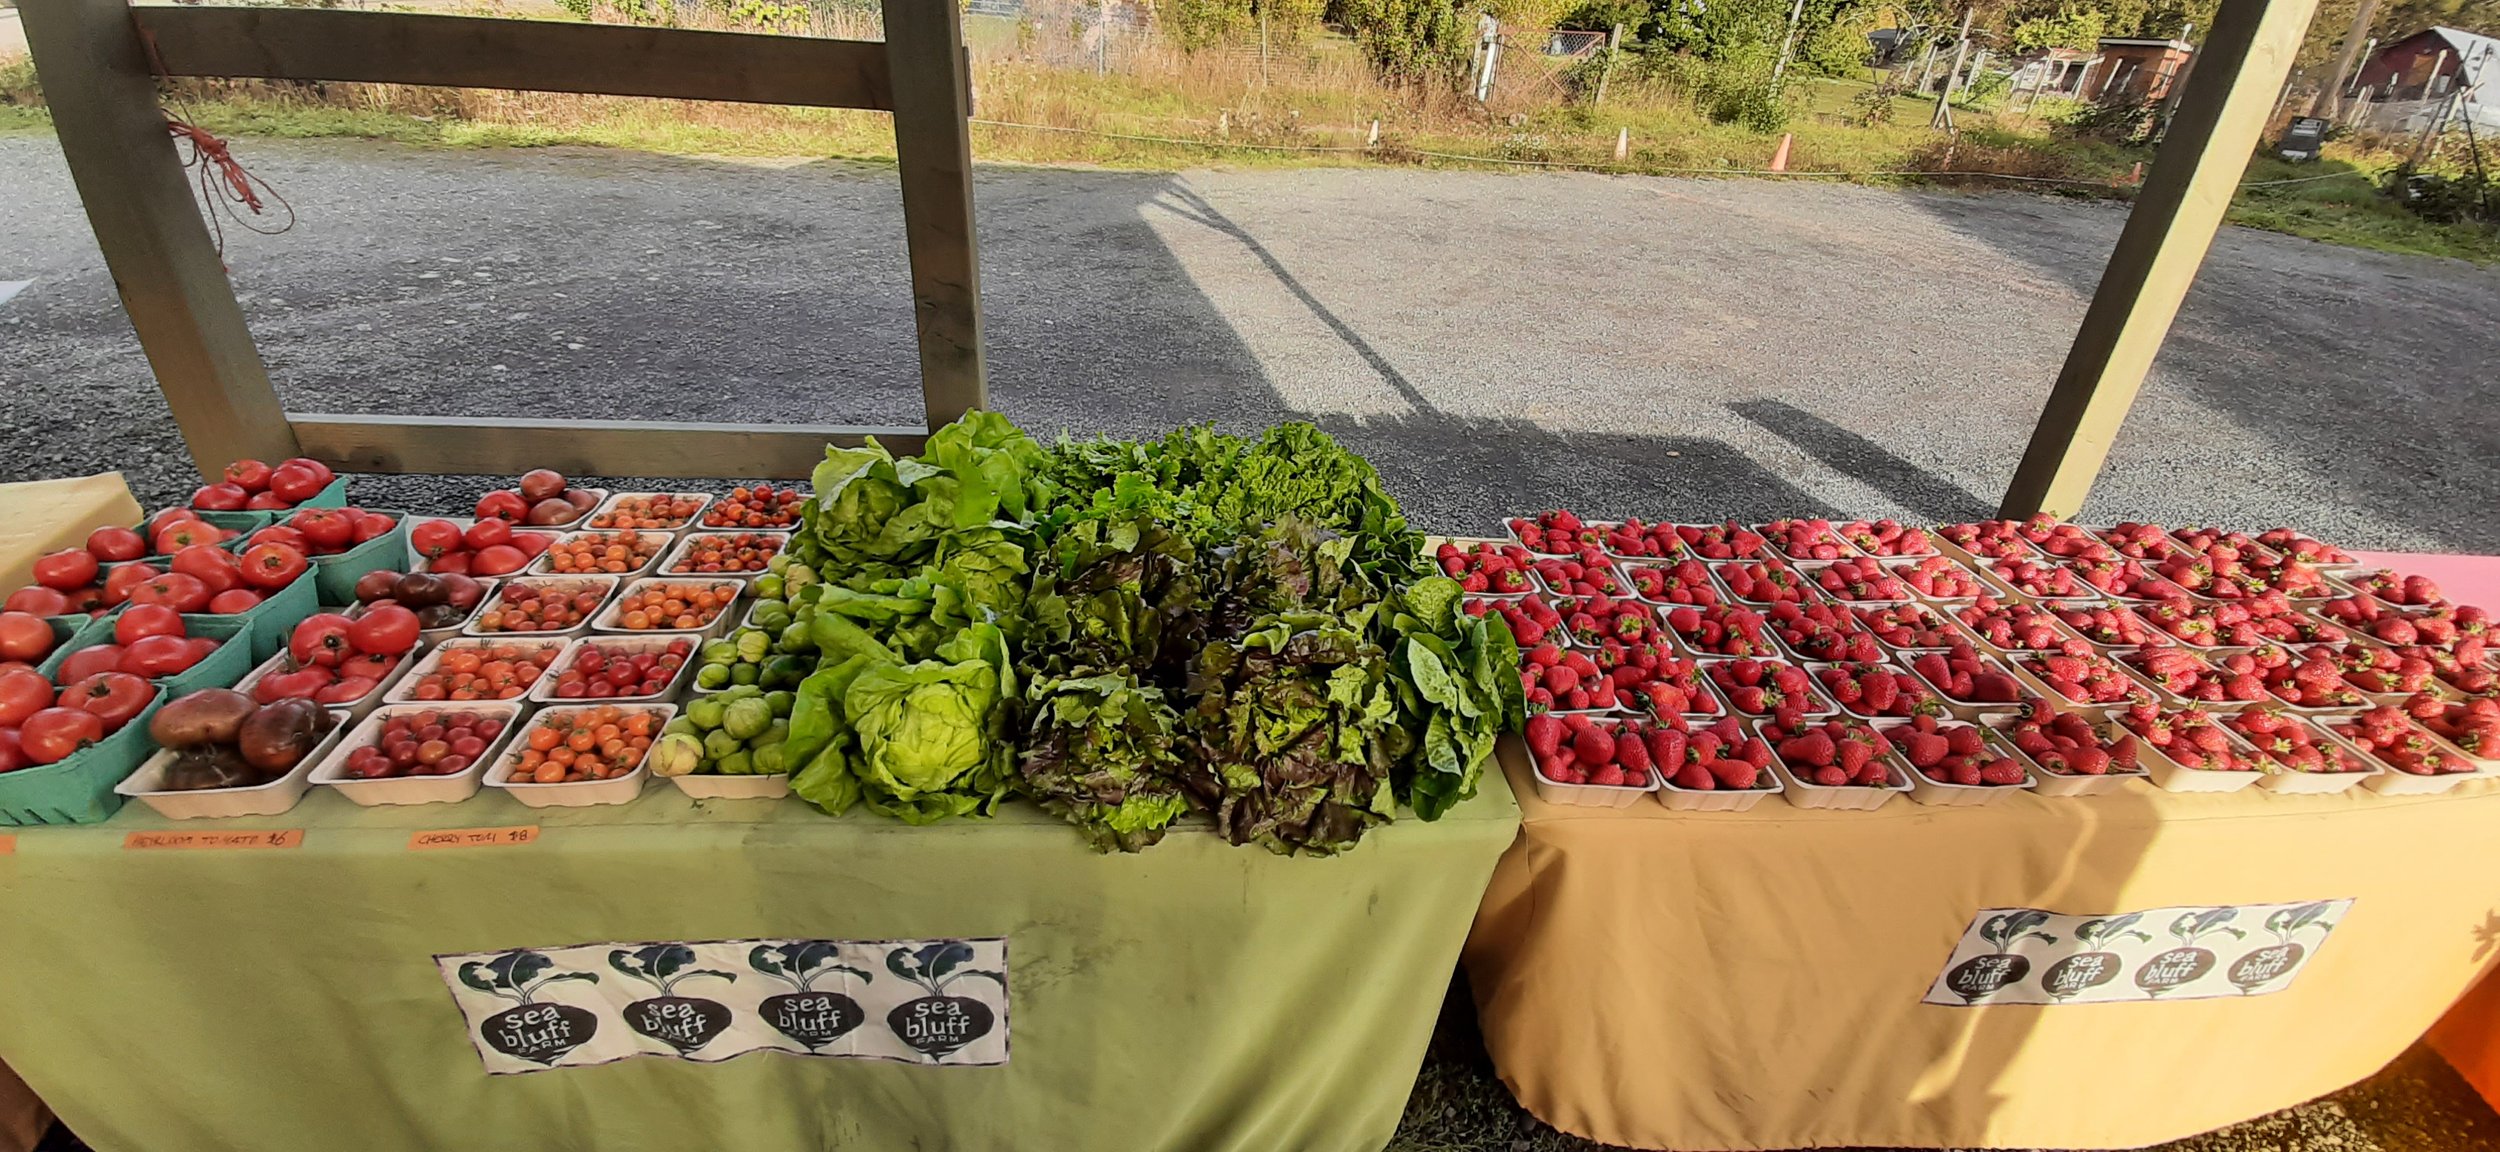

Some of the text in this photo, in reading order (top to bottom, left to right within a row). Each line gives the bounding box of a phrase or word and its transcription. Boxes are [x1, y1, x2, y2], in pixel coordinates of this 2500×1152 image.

[267, 831, 289, 846] $6
[2068, 955, 2105, 968] sea
[2160, 951, 2198, 964] sea
[2256, 946, 2290, 962] sea
[1975, 956, 2012, 969] sea
[2237, 956, 2288, 977] bluff
[1957, 968, 2012, 985] bluff
[2053, 966, 2104, 986] bluff
[2144, 962, 2198, 981] bluff
[647, 1003, 695, 1018] sea
[784, 996, 832, 1012] sea
[914, 1000, 963, 1016] sea
[504, 1006, 561, 1029] sea
[777, 1010, 841, 1031] bluff
[498, 1019, 570, 1048] bluff
[641, 1014, 706, 1038] bluff
[905, 1015, 970, 1039] bluff
[916, 1035, 960, 1044] FARM
